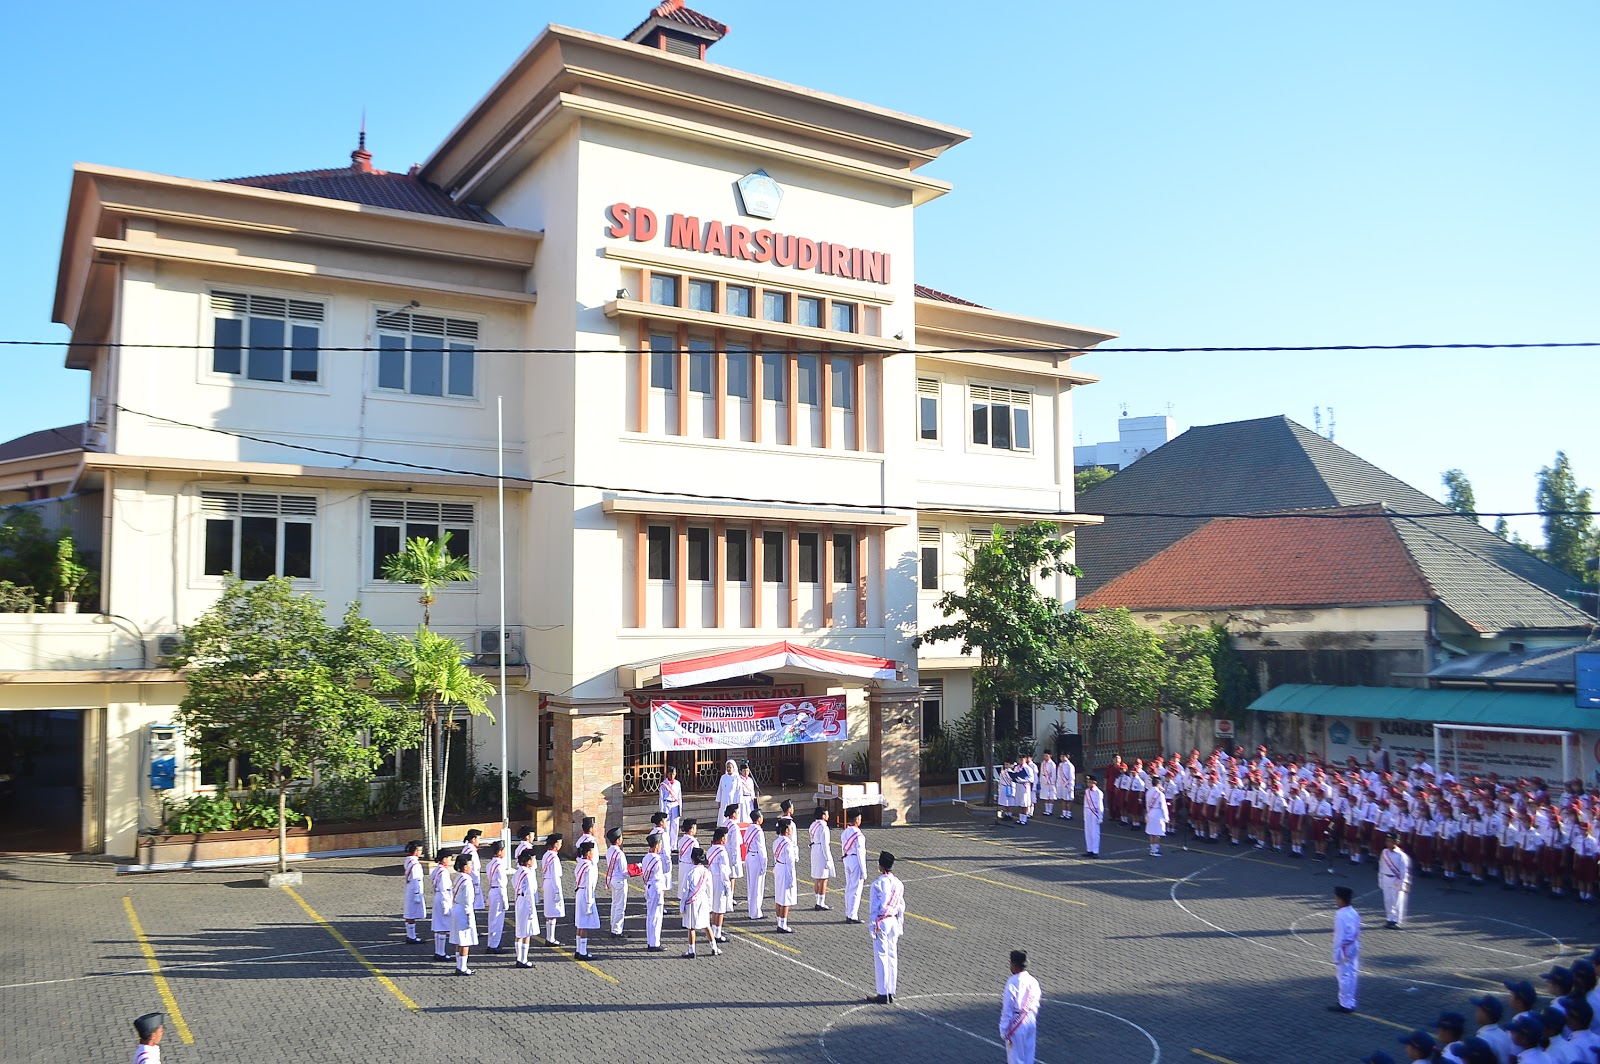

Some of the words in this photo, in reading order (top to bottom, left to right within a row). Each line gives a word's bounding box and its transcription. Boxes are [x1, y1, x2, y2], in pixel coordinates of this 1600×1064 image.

[605, 202, 658, 242] SD
[666, 212, 892, 285] MARSUDIRINI
[701, 705, 755, 719] DIRGAHAYU
[681, 719, 727, 734] REPUBLIK
[728, 717, 776, 733] INDONESIA
